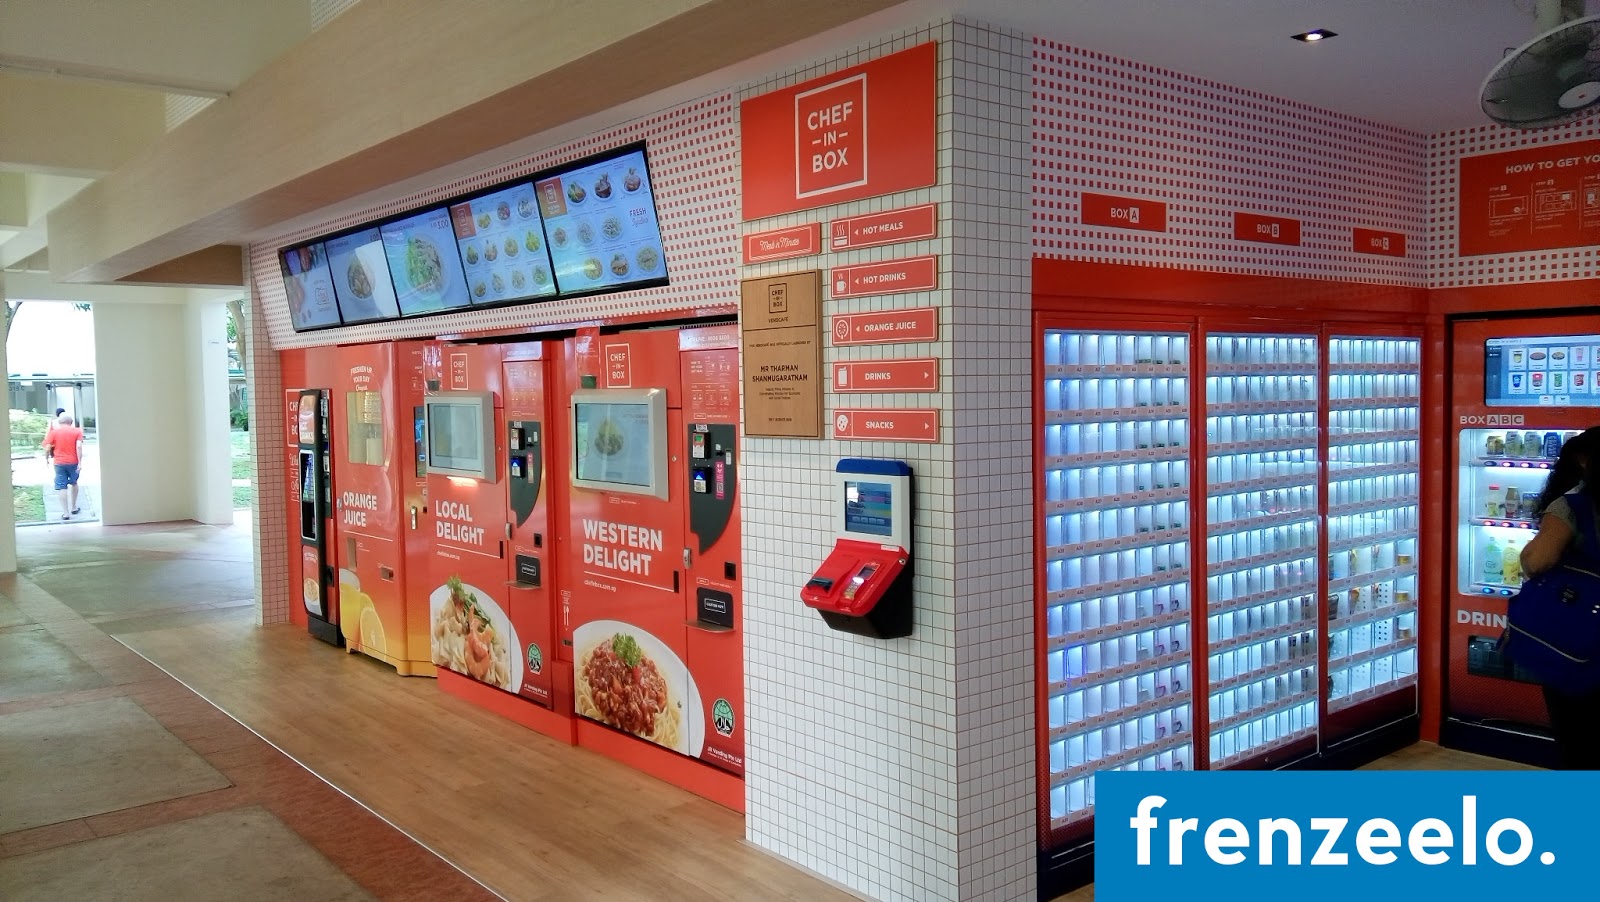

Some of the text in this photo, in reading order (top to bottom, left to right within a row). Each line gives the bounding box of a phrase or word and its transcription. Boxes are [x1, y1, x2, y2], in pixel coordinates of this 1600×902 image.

[807, 101, 853, 130] CHEF
[812, 148, 849, 173] BOX
[1505, 162, 1535, 174] HOW
[1538, 160, 1554, 170] TO
[1556, 157, 1581, 167] GET
[1110, 207, 1138, 222] BOX A
[862, 221, 904, 235] HOT MEALS
[1257, 224, 1278, 236] BOX B
[1371, 238, 1383, 248] BOX
[863, 272, 907, 285] HOT DRINKS
[864, 321, 917, 332] ORANGE JUICE
[610, 353, 626, 362] CHEF
[760, 364, 799, 373] MR THARMAN
[612, 371, 625, 380] BOX
[752, 374, 808, 383] SHANMUGARATNAM
[864, 372, 891, 381] DRINKS
[865, 421, 894, 430] SNACKS
[1460, 415, 1486, 425] BOX
[343, 492, 377, 511] ORANGE
[435, 500, 473, 522] LOCAL
[343, 511, 367, 528] JUICE
[436, 521, 485, 546] DELIGHT
[582, 519, 663, 552] WESTERN
[583, 544, 652, 576] DELIGHT
